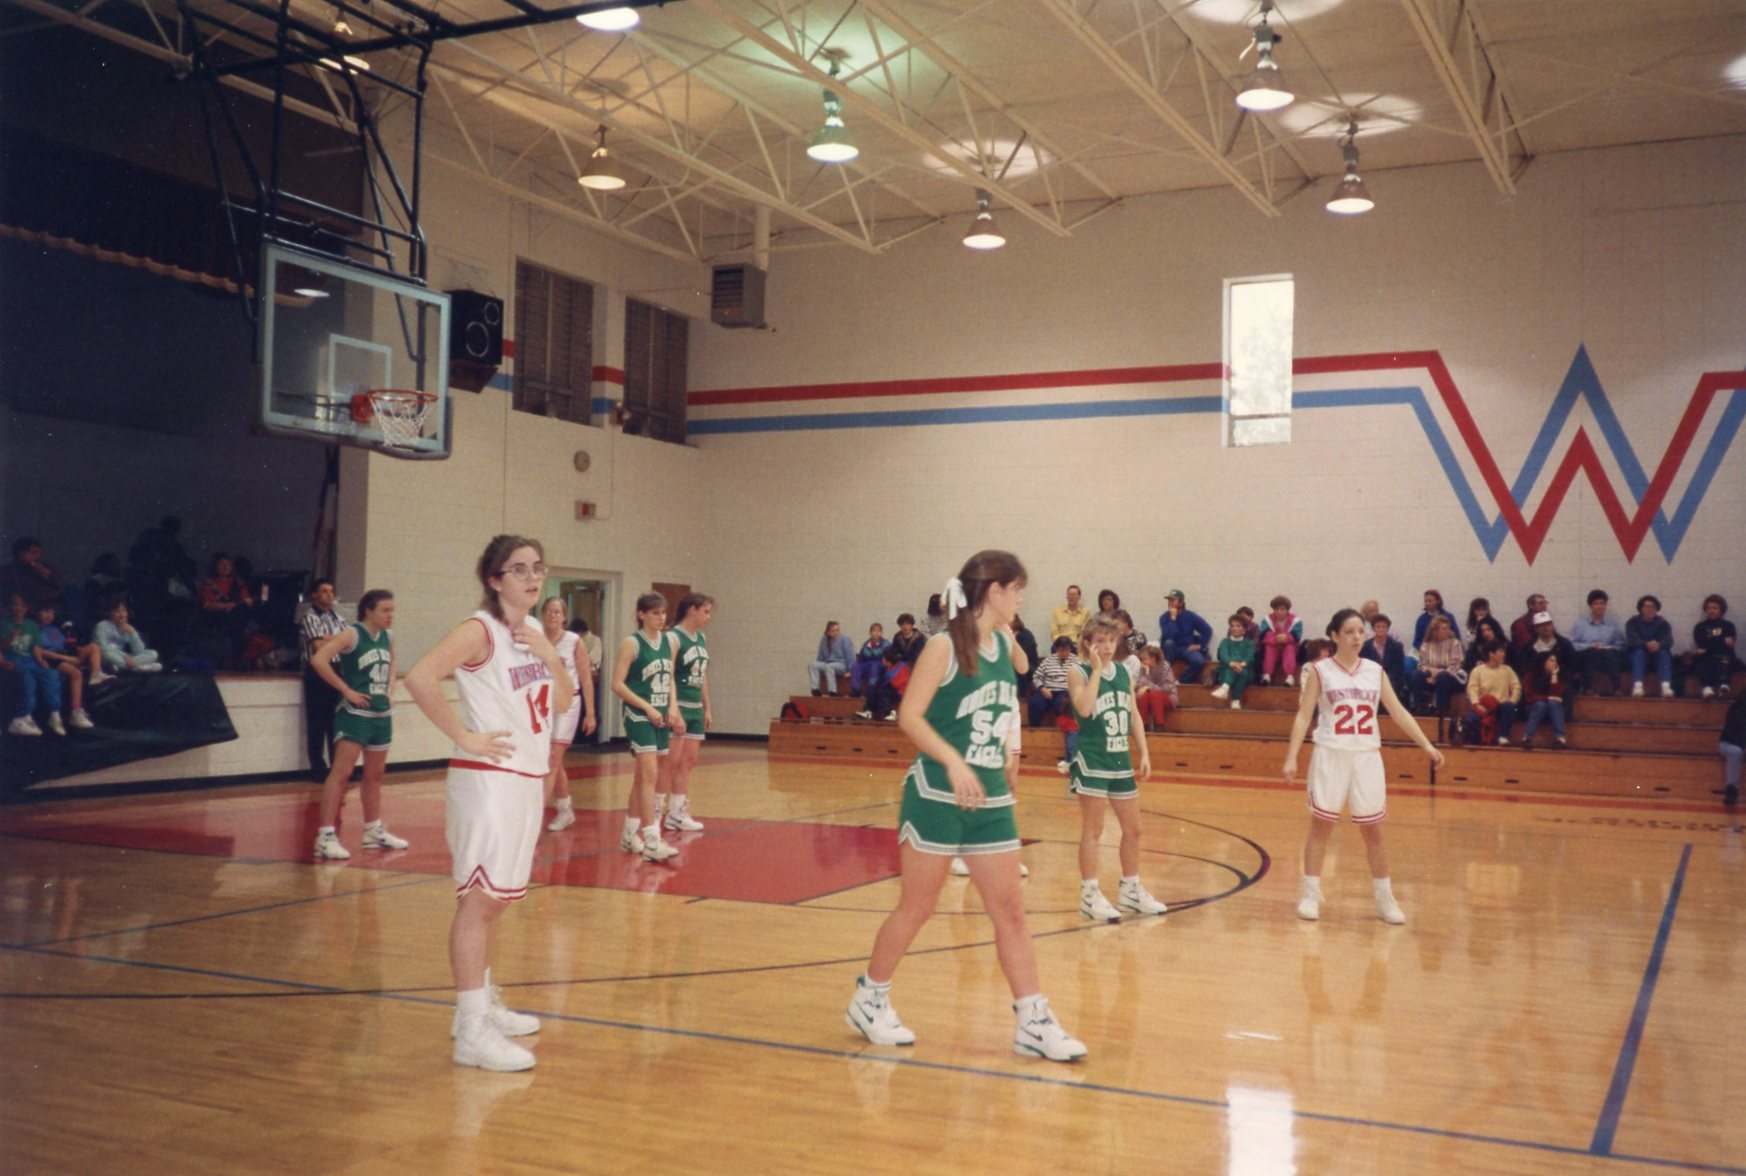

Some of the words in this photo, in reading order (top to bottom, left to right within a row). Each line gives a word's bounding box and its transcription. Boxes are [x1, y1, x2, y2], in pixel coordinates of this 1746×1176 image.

[526, 684, 550, 734] 14
[1103, 710, 1129, 736] 30
[1334, 704, 1373, 735] 22
[970, 709, 1013, 746] 54
